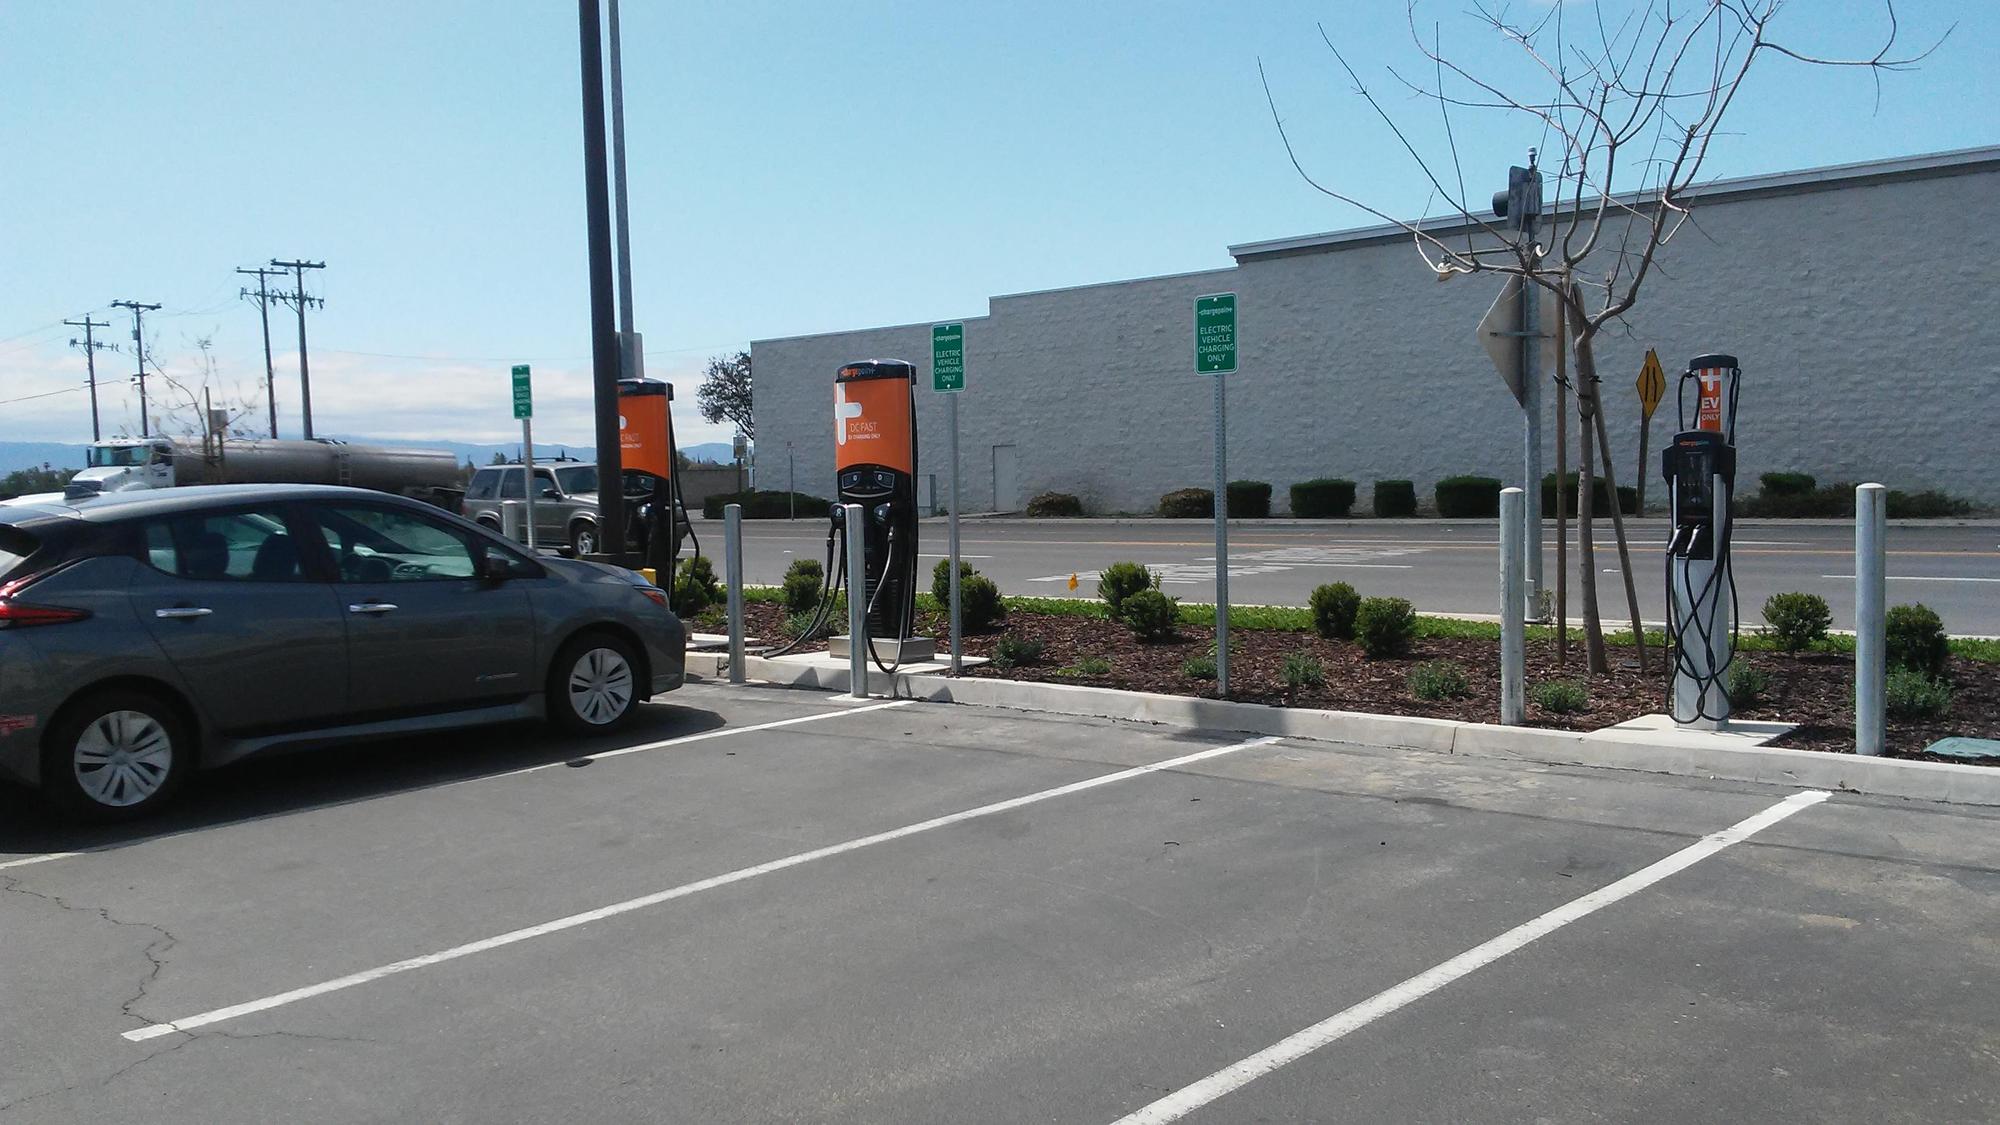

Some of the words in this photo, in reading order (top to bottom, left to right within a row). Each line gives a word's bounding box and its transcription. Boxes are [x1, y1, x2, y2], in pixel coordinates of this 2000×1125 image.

[1200, 325, 1233, 335] ELECTRIC
[1202, 334, 1231, 344] VEHICLE
[1199, 343, 1235, 353] CHARGING
[936, 350, 961, 358] ELECTRIC
[1207, 353, 1226, 362] ONLY
[938, 358, 960, 366] VEHICLE
[935, 366, 963, 374] CHARGING
[941, 374, 956, 382] ONLY
[1701, 396, 1720, 409] EV
[1701, 413, 1721, 421] ONLY
[850, 423, 861, 433] DC
[861, 421, 877, 432] FAST
